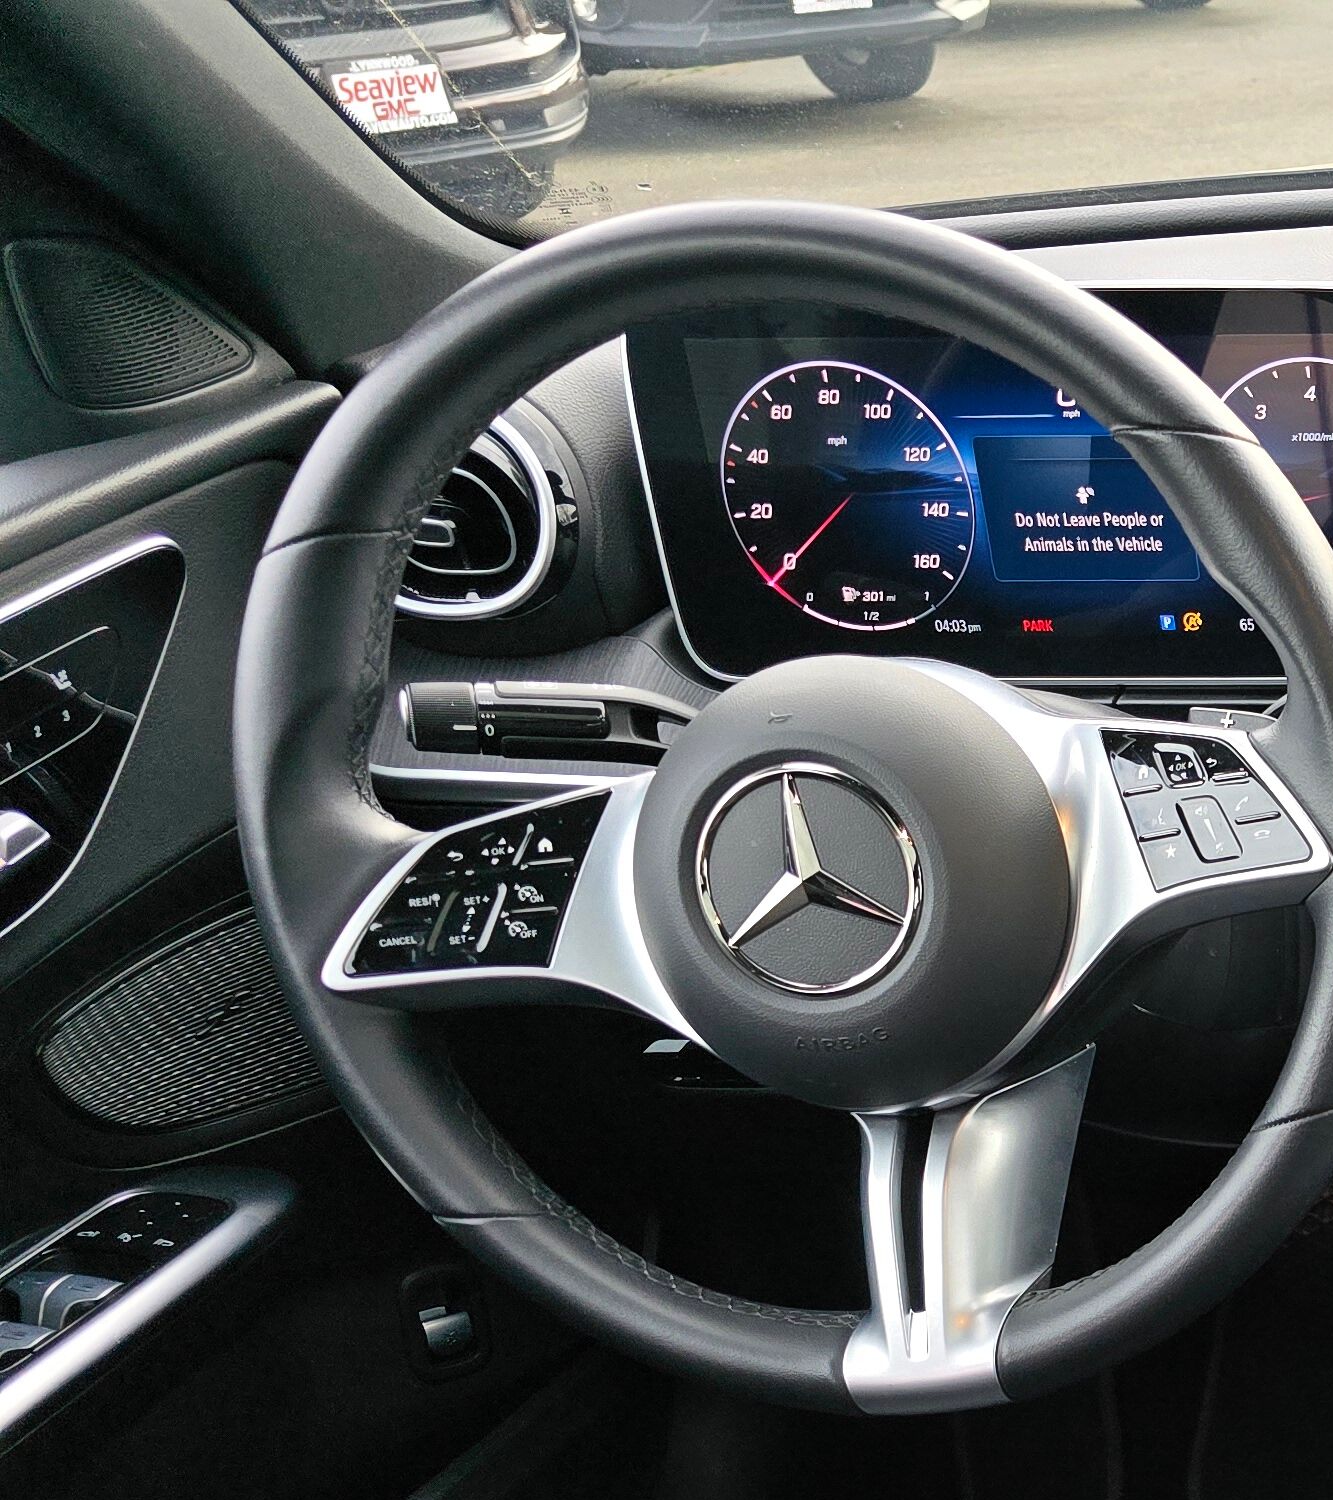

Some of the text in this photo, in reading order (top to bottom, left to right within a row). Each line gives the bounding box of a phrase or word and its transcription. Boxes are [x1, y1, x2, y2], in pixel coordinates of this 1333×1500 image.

[339, 70, 437, 104] Seaview
[372, 98, 421, 121] GMC
[817, 389, 840, 405] 80
[1304, 385, 1317, 401] 4
[770, 404, 792, 420] 60
[863, 404, 891, 420] 100
[1063, 409, 1080, 419] mph
[1255, 405, 1267, 420] 3
[827, 434, 848, 446] mph
[747, 449, 769, 465] 40
[904, 446, 931, 463] 120
[750, 503, 773, 519] 20
[922, 502, 949, 518] 140
[1015, 512, 1164, 530] Do Not Leave People or
[1025, 536, 1163, 552] Animals in the Vehicle
[783, 554, 796, 570] 0
[913, 554, 940, 570] 160
[806, 592, 813, 602] 0
[862, 591, 884, 603] 301
[924, 591, 930, 602] 1
[863, 611, 880, 622] 1/2
[1023, 619, 1054, 633] PARK
[1240, 618, 1255, 632] 65
[62, 709, 70, 721] 3
[33, 725, 42, 738] 2
[1175, 762, 1187, 771] OK
[491, 847, 506, 856] OK
[529, 894, 544, 903] ON
[520, 929, 538, 939] OFF
[379, 936, 417, 948] CANCEL
